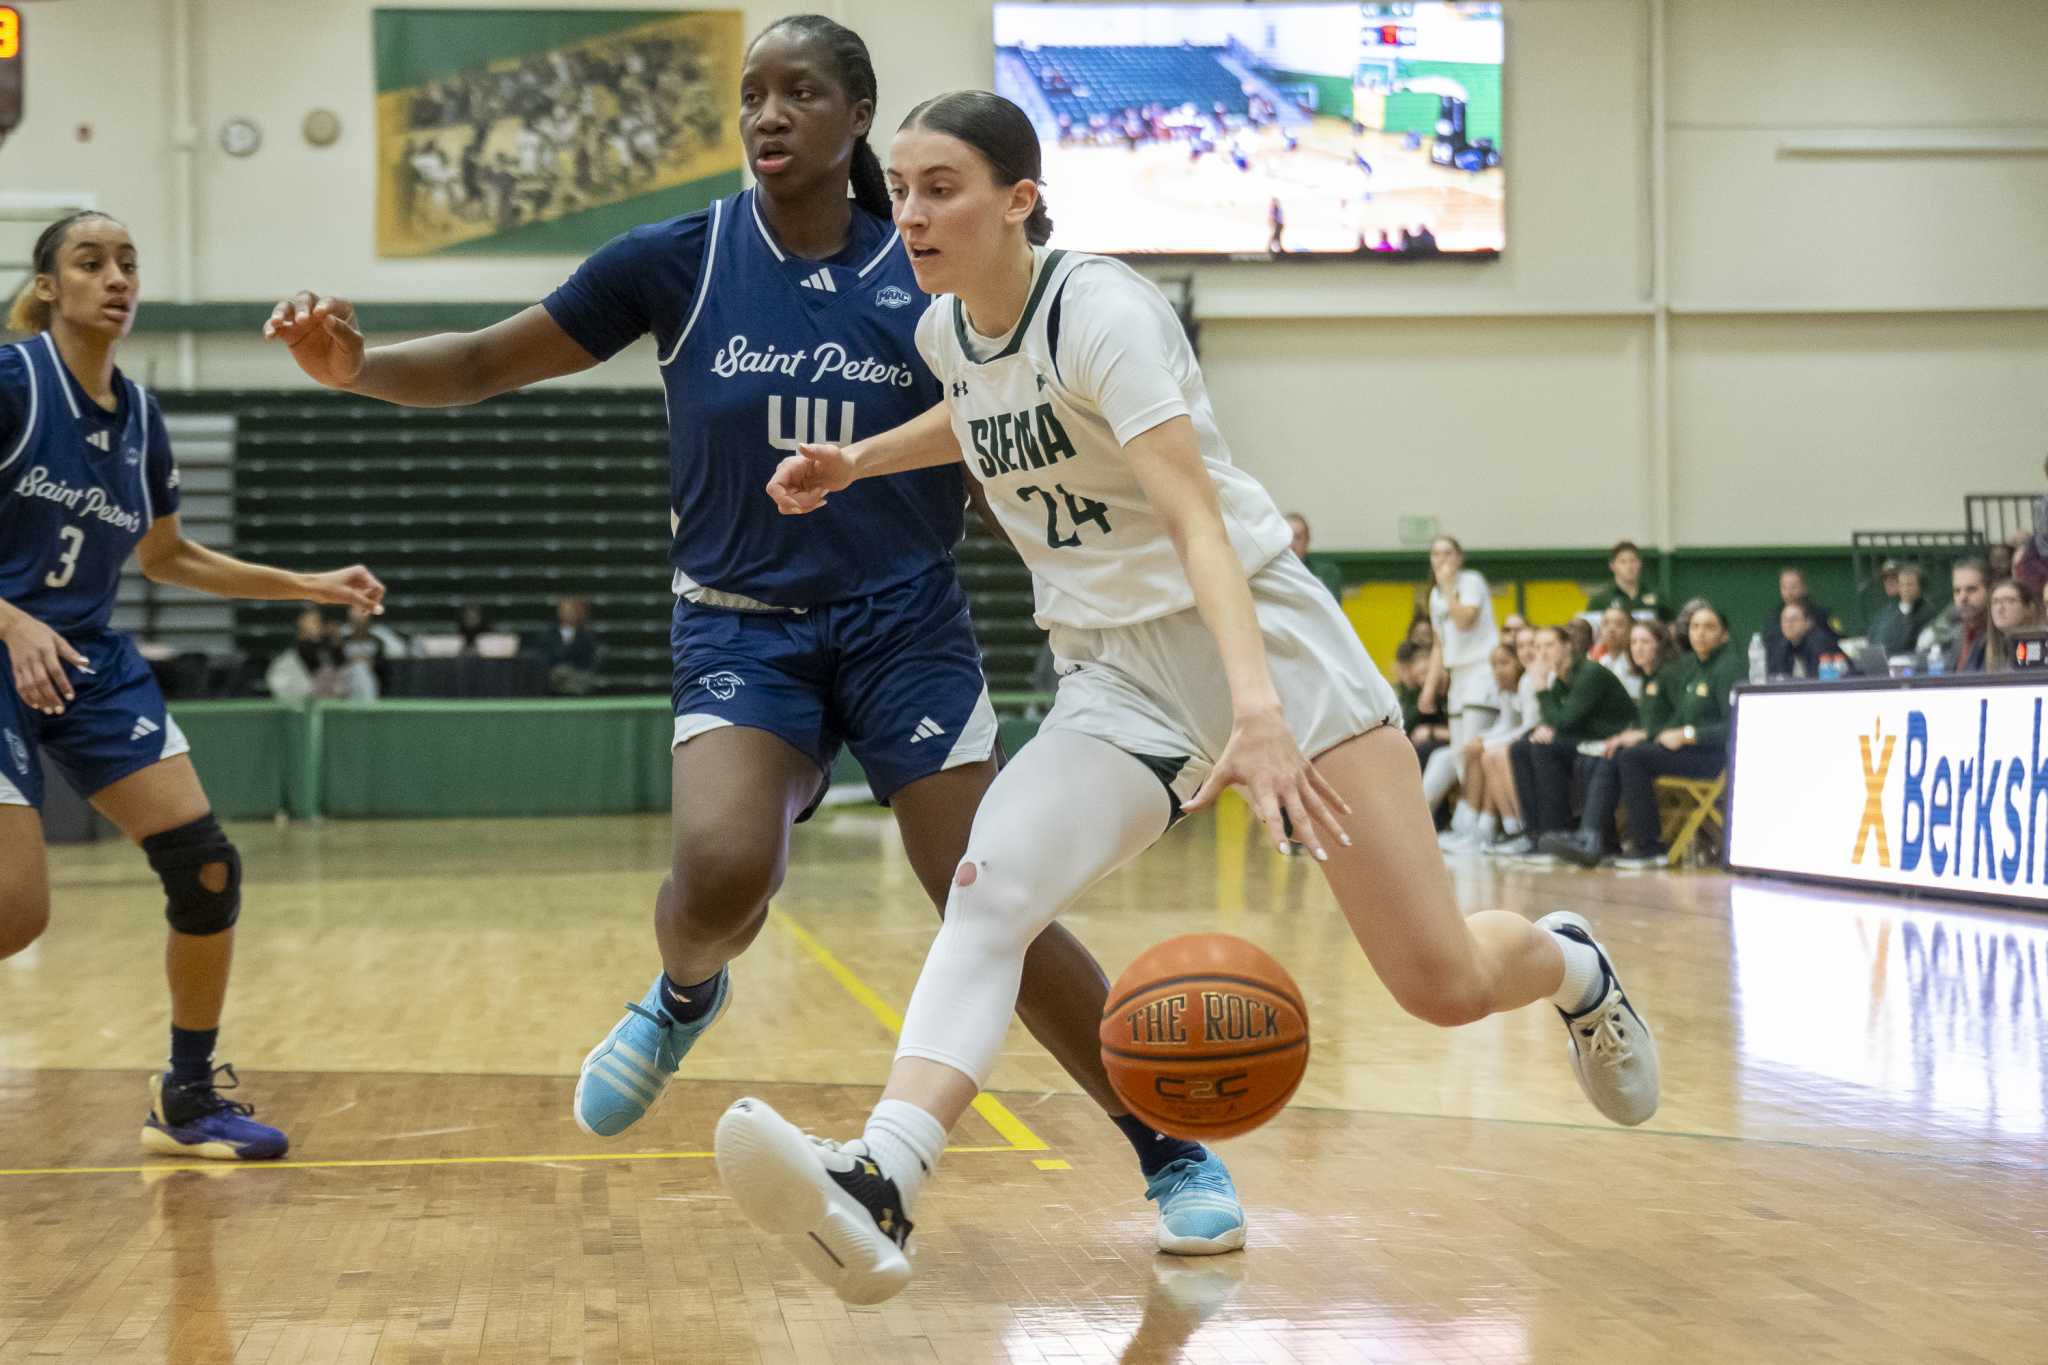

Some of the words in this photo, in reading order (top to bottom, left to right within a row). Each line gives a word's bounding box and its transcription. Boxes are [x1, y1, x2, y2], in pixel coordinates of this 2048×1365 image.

[711, 335, 807, 378] Saint
[810, 342, 913, 387] Peter's
[768, 395, 855, 456] 44
[968, 402, 1077, 478] SIENA
[14, 466, 83, 510] Saint
[78, 487, 141, 533] Peter's
[1016, 483, 1112, 549] 24
[45, 525, 85, 587] 3
[1127, 992, 1188, 1044] THE
[1201, 991, 1280, 1043] ROCK
[1154, 1073, 1248, 1100] C2C
